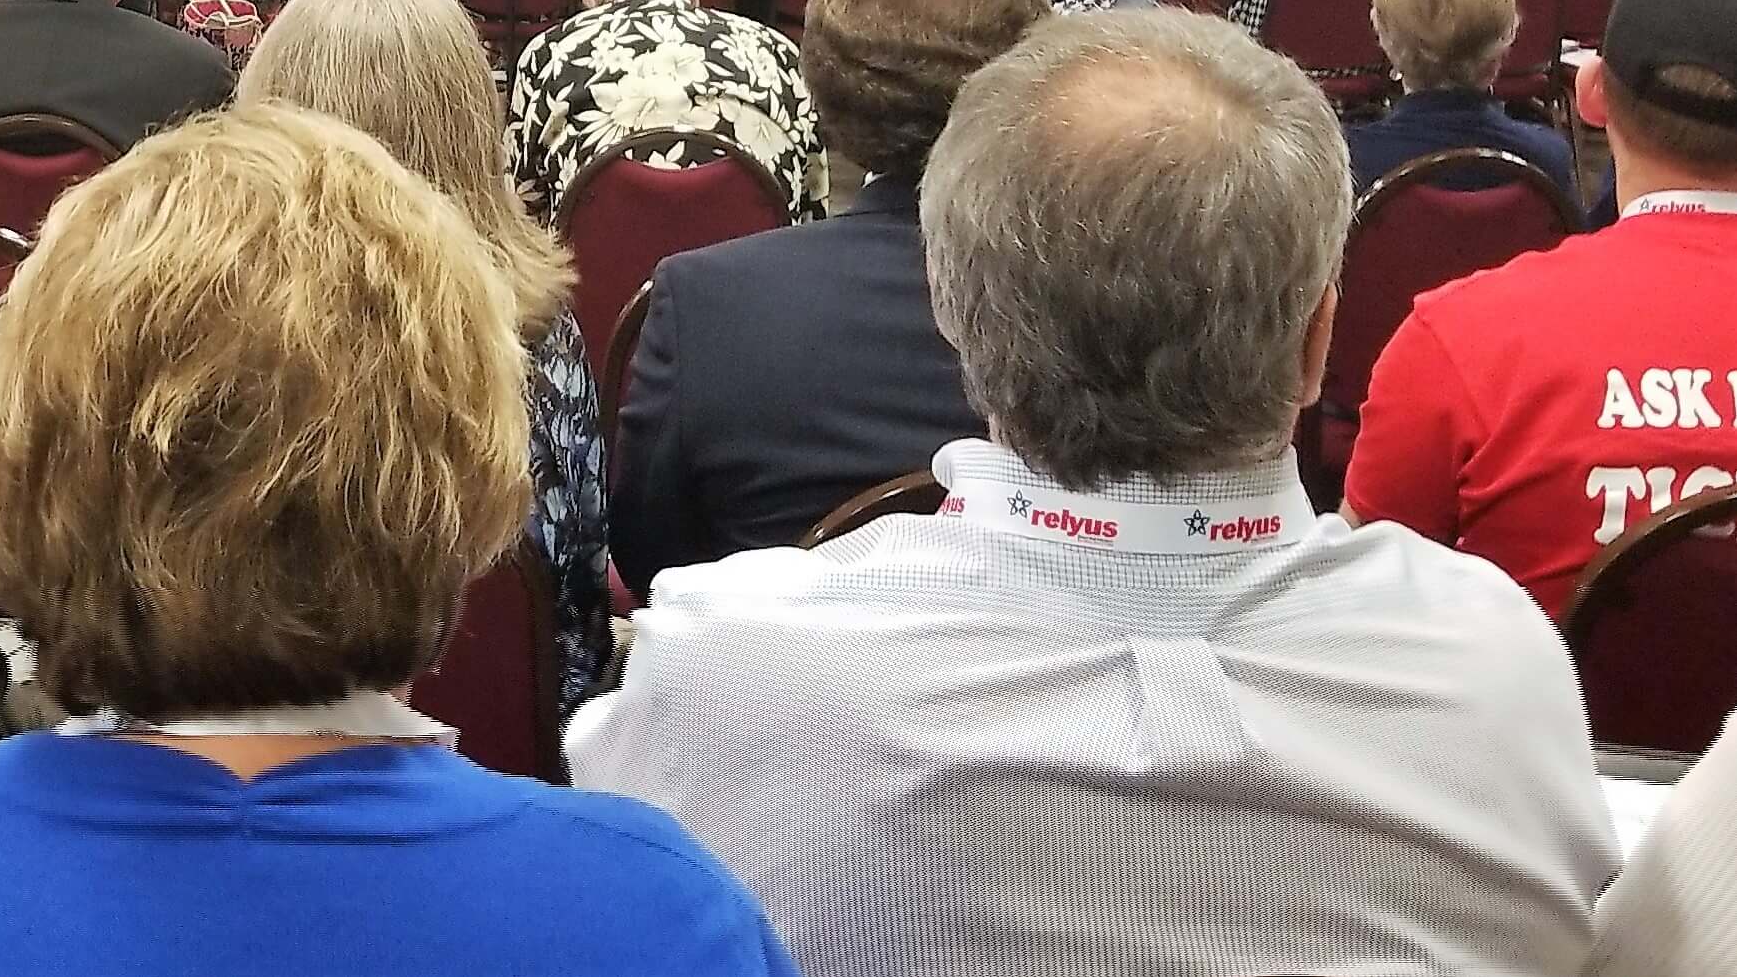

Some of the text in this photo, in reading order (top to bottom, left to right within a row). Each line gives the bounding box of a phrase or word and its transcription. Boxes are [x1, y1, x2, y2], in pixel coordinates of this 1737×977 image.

[1597, 368, 1722, 428] ASK
[1030, 509, 1118, 538] relyus
[1209, 514, 1281, 542] relyus
